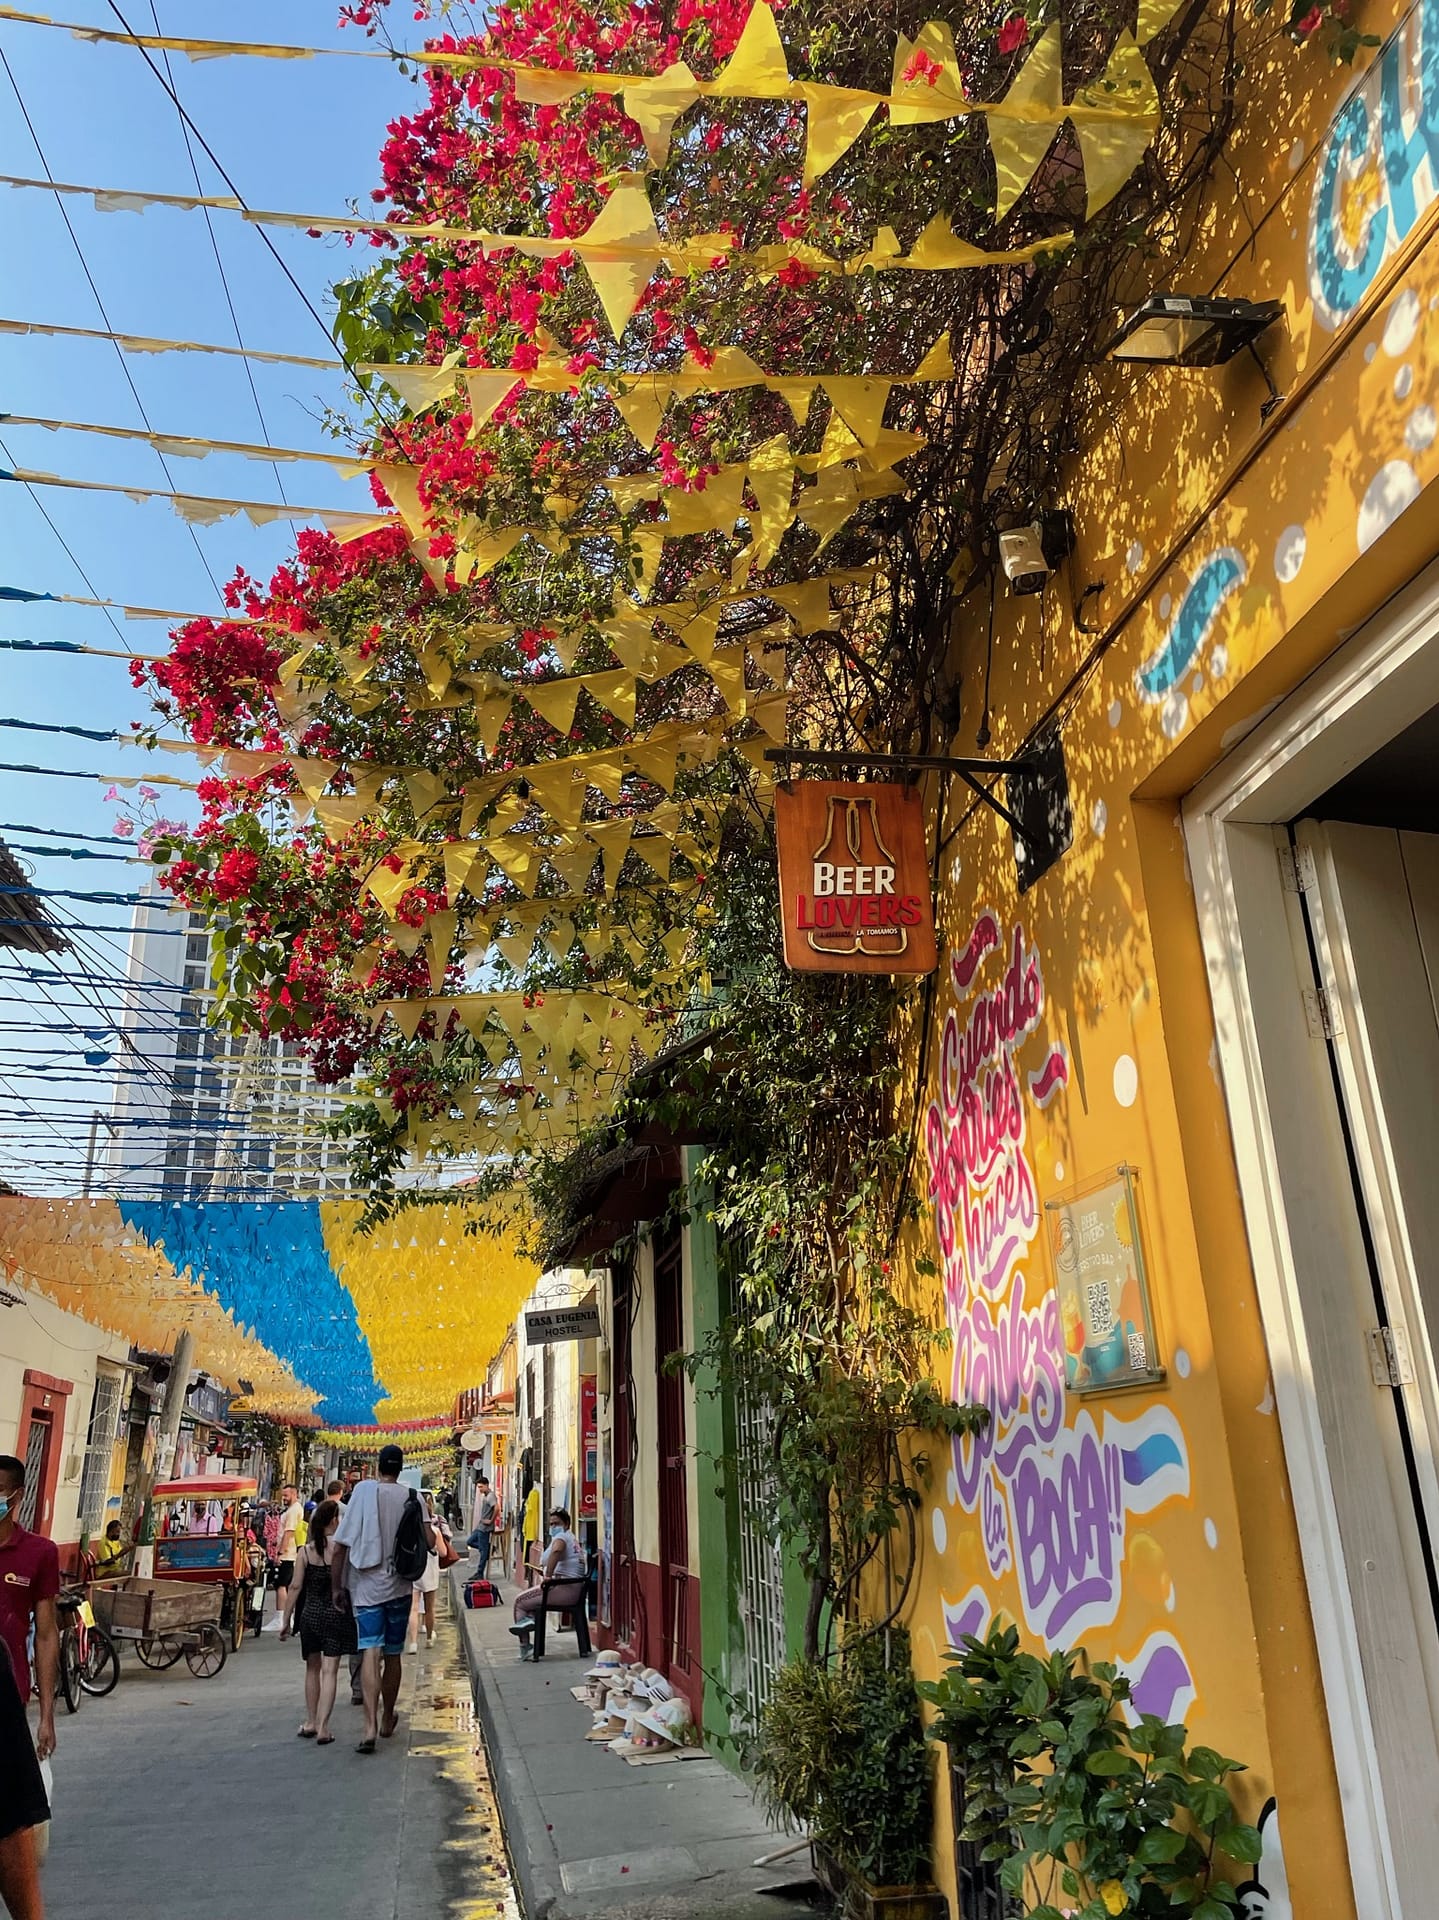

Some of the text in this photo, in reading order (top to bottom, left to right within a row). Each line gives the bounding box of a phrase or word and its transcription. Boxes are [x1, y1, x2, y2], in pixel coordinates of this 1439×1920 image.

[813, 862, 896, 896] BEER
[796, 895, 922, 929] LOVERS
[528, 1311, 597, 1327] CASA EUGENIA
[545, 1326, 583, 1337] HOSTEL
